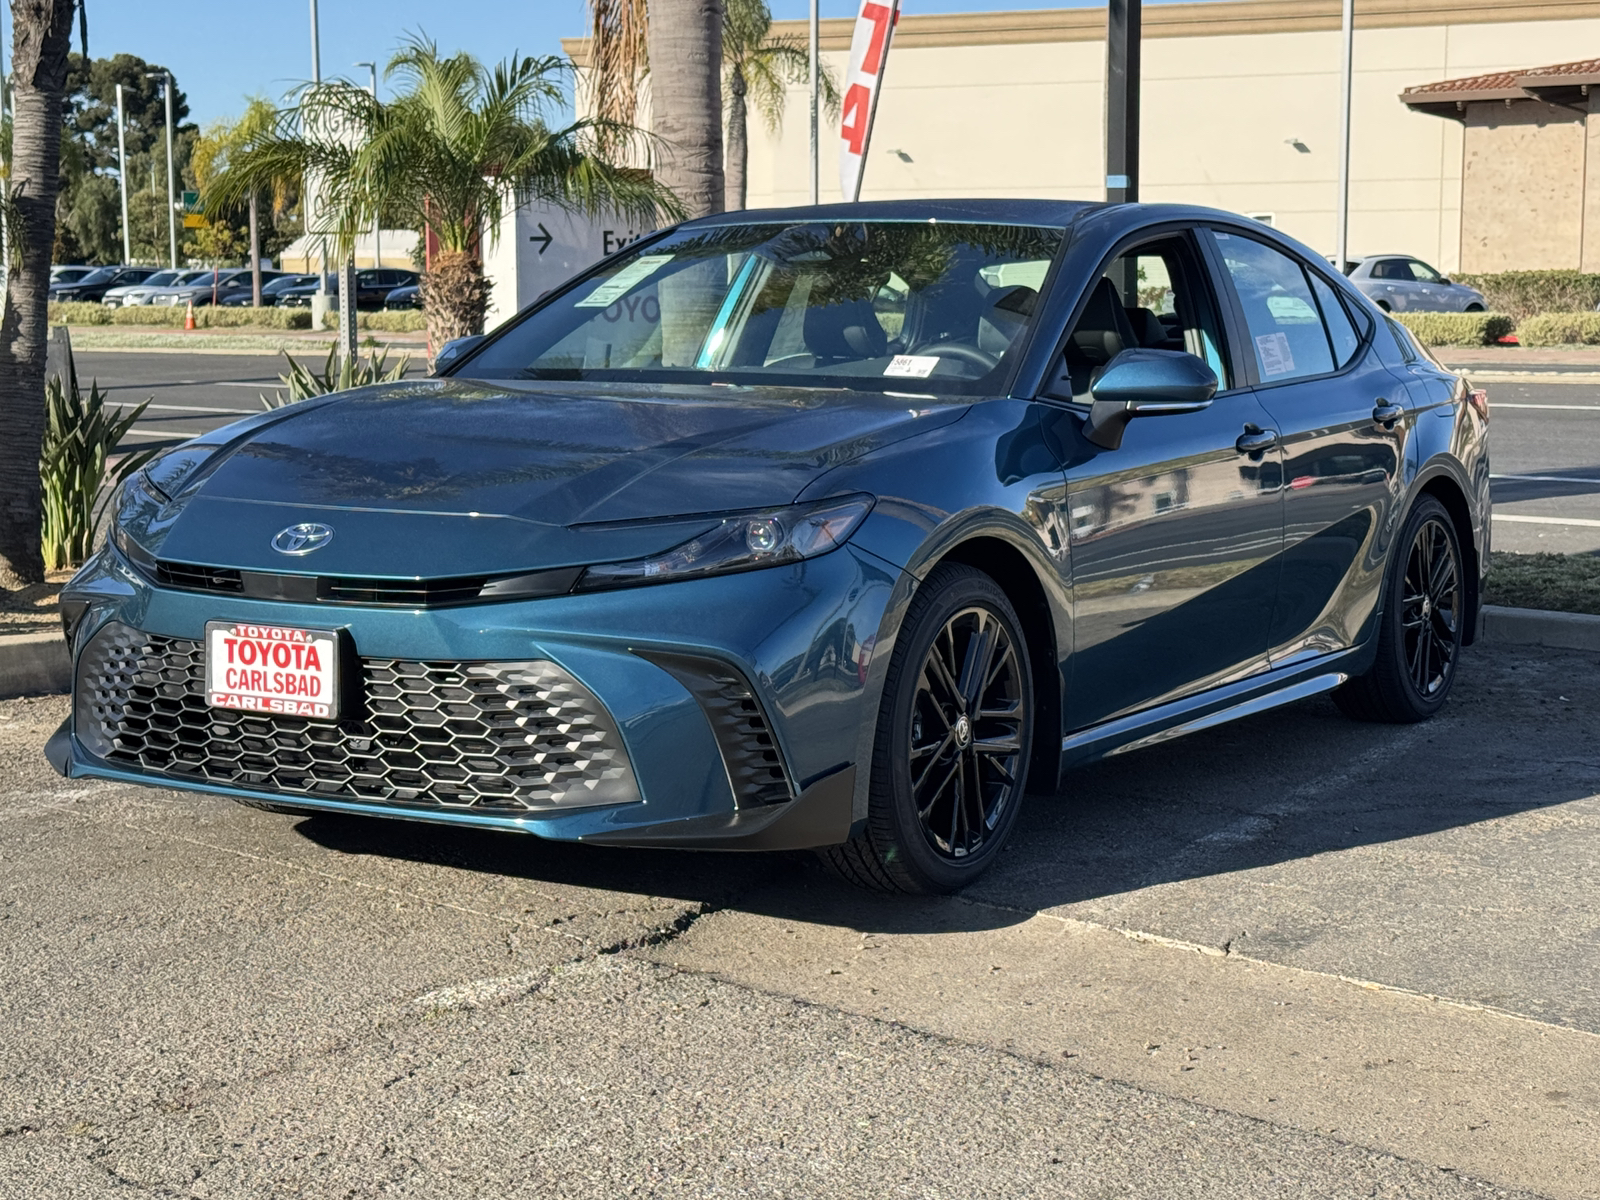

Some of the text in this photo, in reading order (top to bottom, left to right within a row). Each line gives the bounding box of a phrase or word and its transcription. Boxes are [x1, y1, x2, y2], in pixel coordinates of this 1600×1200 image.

[603, 230, 640, 256] Exi
[237, 625, 304, 642] TOYOTA
[223, 638, 322, 671] TOYOTA
[225, 667, 321, 697] CARLSBAD
[211, 693, 329, 716] CARLSBAD
